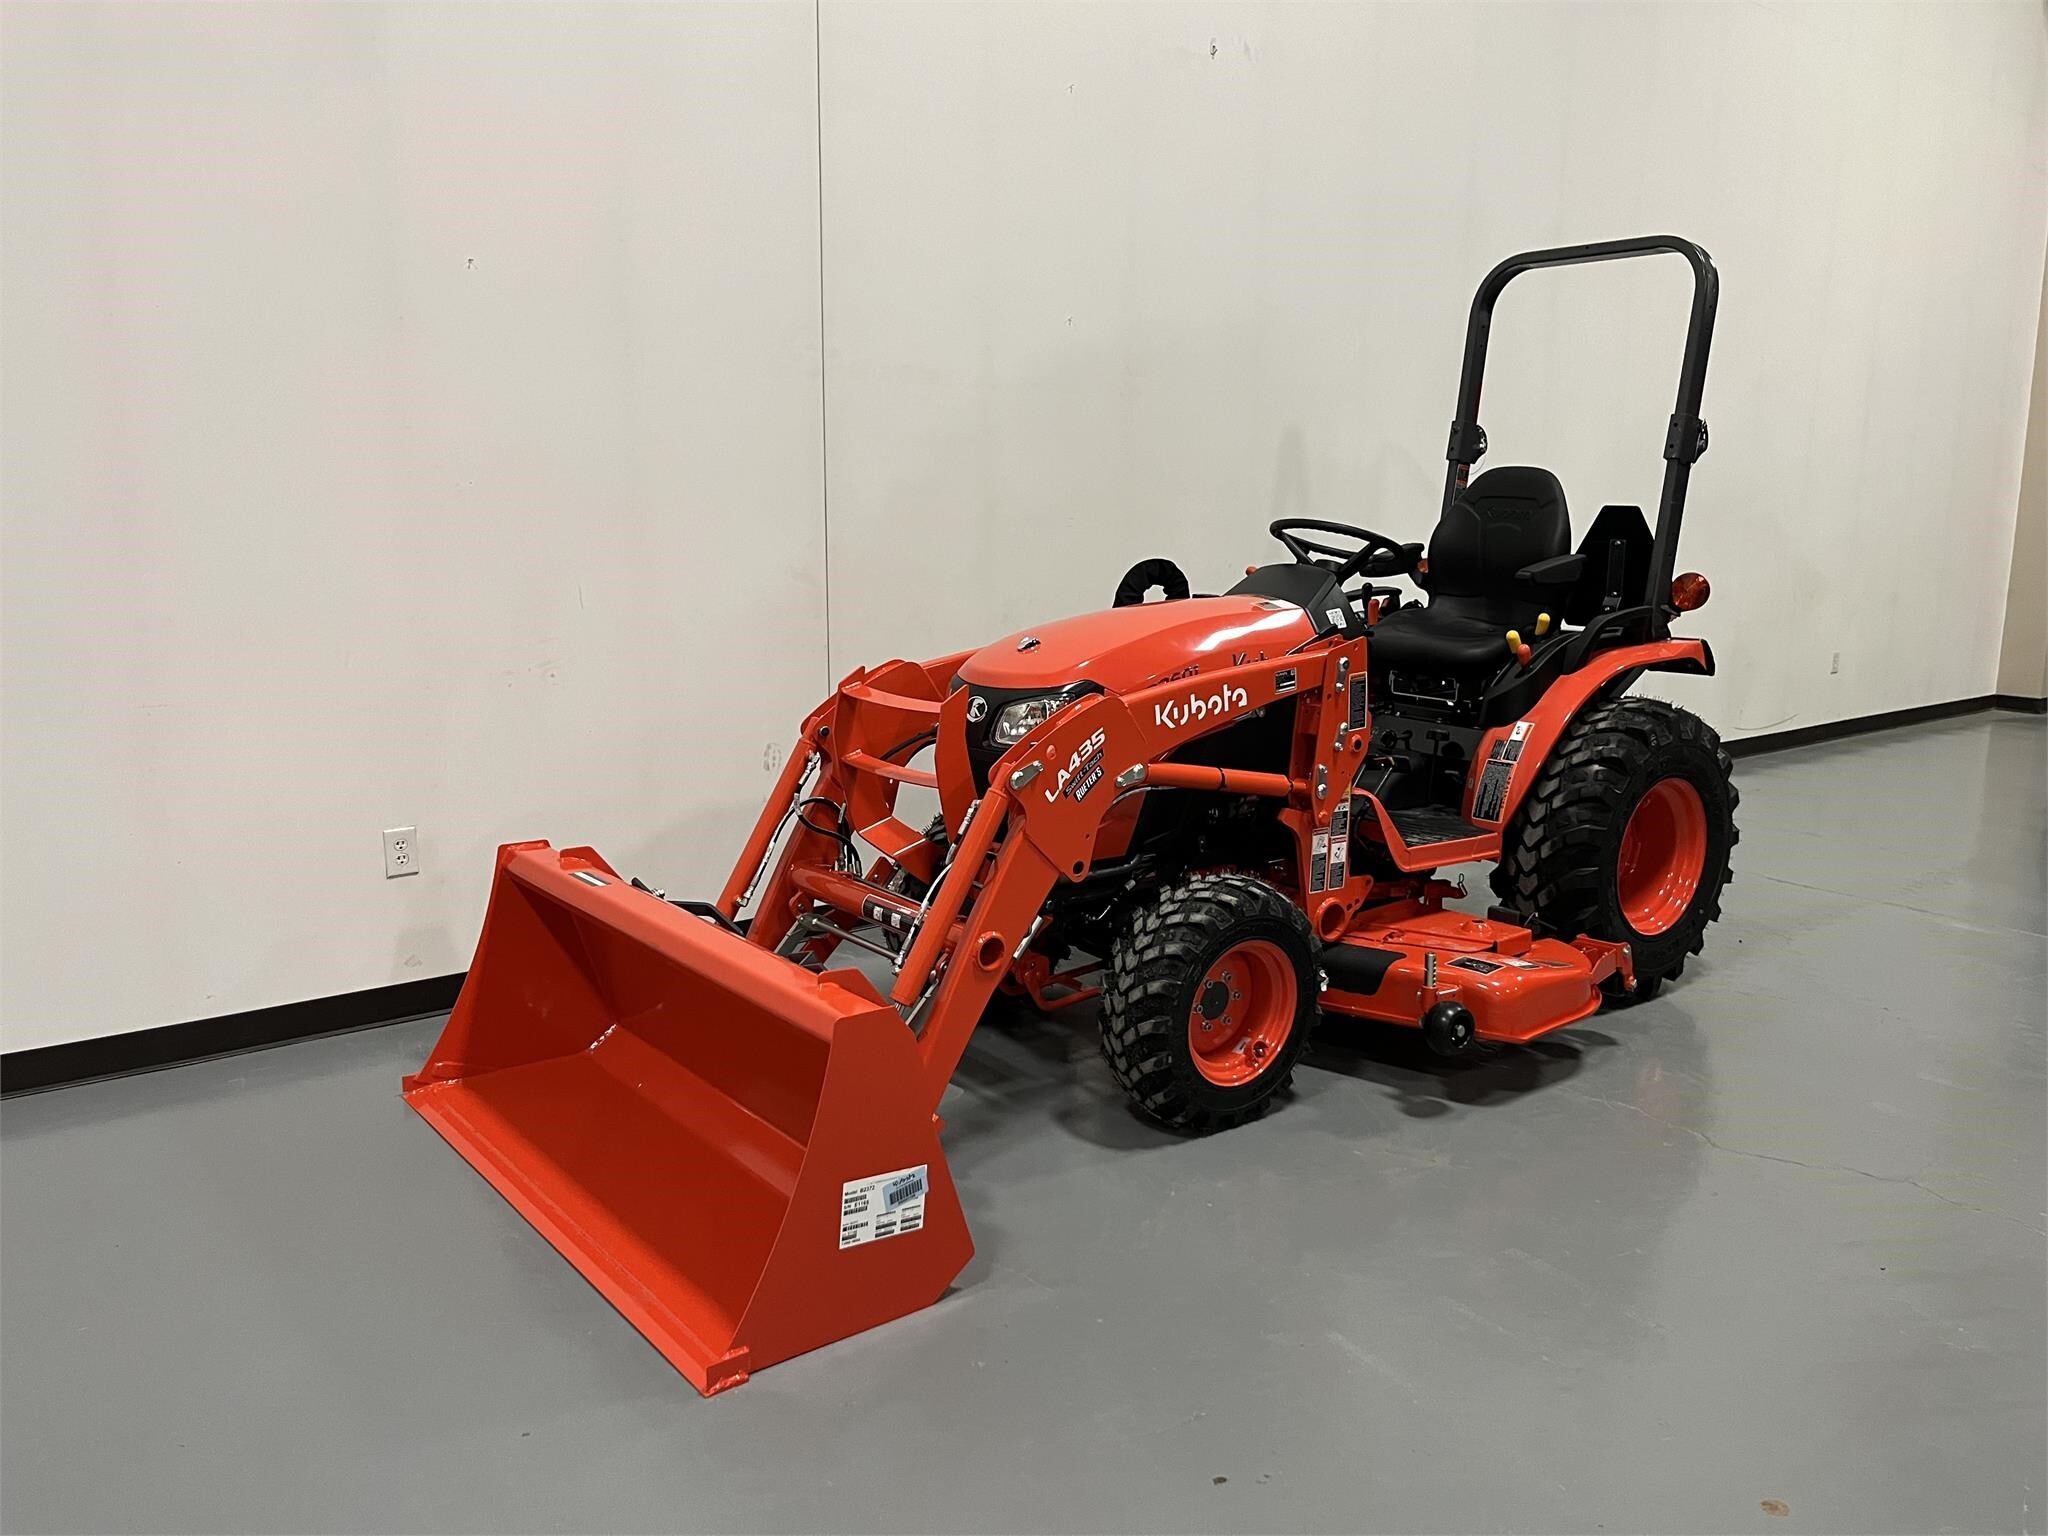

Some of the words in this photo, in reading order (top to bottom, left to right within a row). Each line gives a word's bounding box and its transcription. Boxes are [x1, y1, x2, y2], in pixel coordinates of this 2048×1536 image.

[1154, 683, 1248, 729] Kubota
[1044, 727, 1105, 803] LA435
[1075, 766, 1103, 801] RUETER'S
